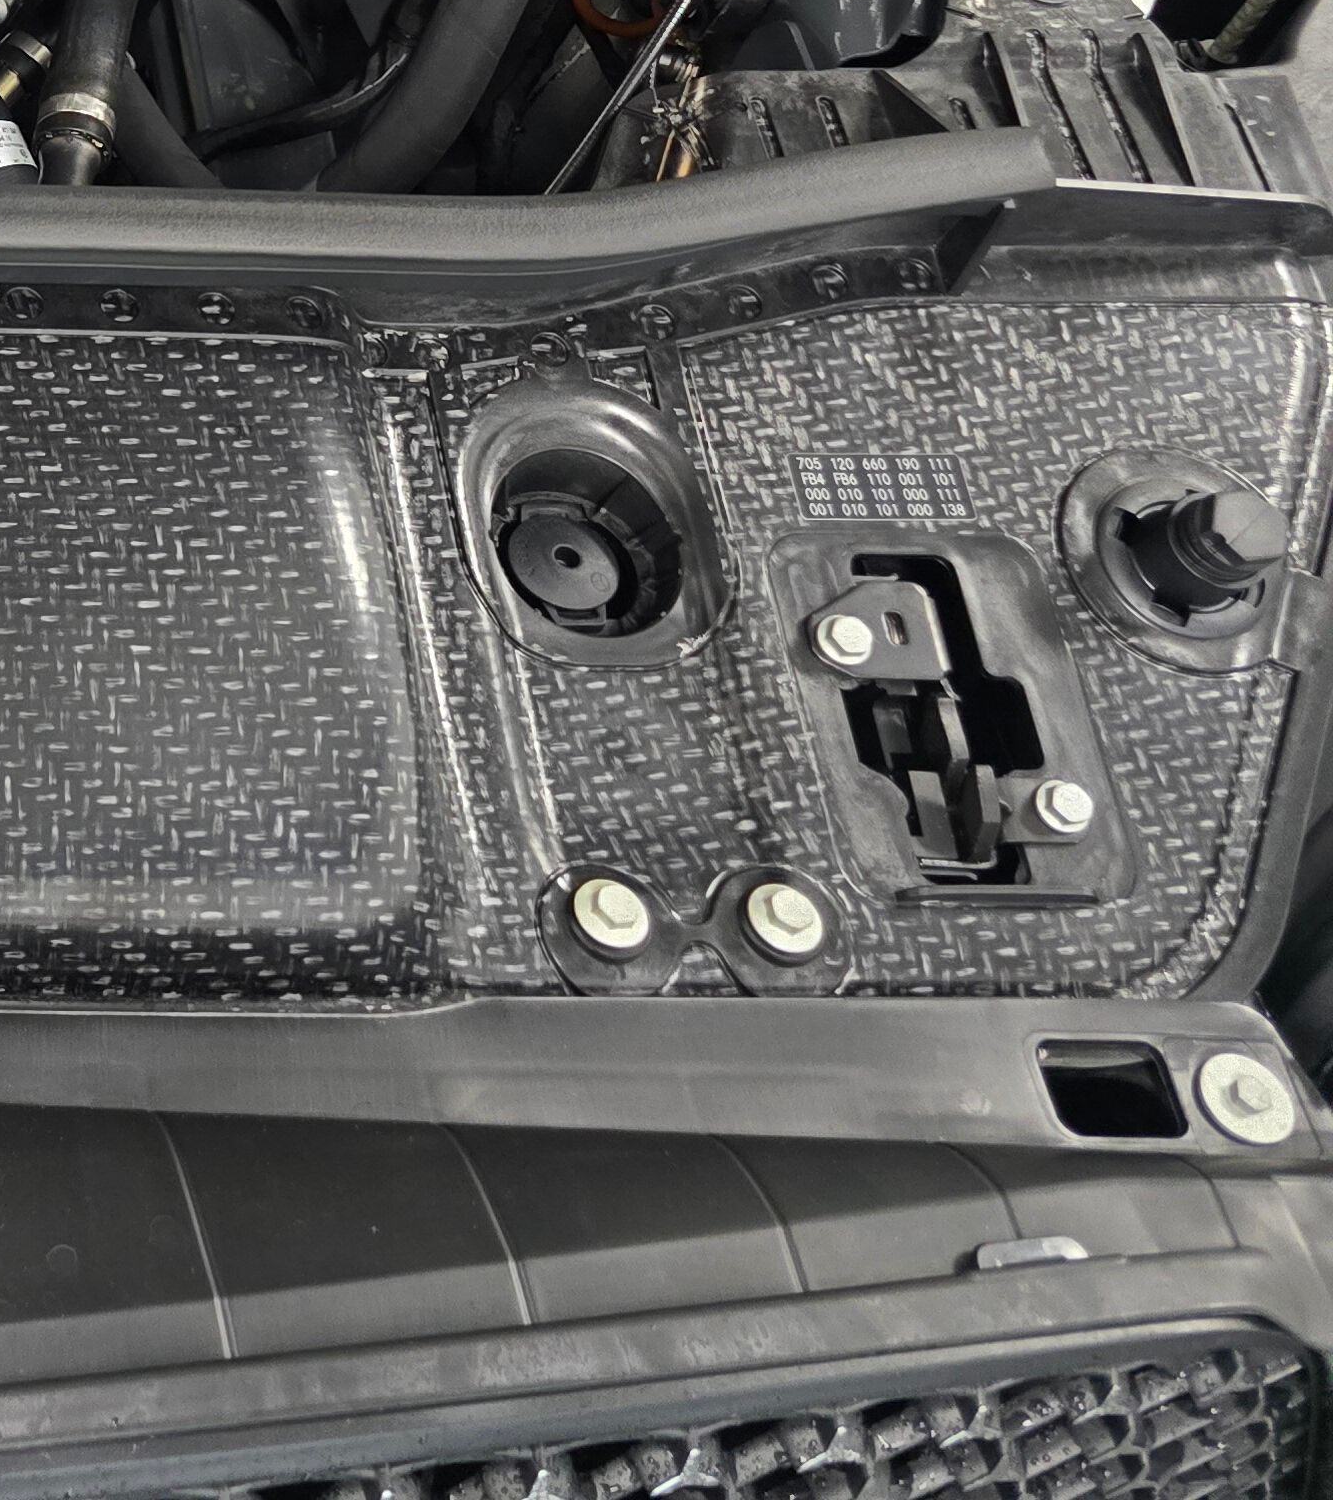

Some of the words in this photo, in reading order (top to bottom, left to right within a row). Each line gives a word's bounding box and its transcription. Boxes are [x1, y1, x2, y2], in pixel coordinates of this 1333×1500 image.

[796, 457, 822, 470] 705
[830, 457, 855, 470] 120
[862, 457, 887, 470] 660
[895, 457, 920, 470] 190
[928, 457, 951, 470] 111
[800, 472, 825, 486] FB4
[833, 472, 858, 486] FB6
[867, 472, 891, 486] 110
[898, 472, 923, 486] 001
[932, 472, 956, 486] 101
[805, 488, 830, 501] 000
[838, 488, 863, 501] 010
[871, 488, 895, 501] 101
[903, 488, 928, 501] 000
[937, 488, 961, 501] 111
[809, 503, 834, 517] 001
[842, 503, 867, 517] 010
[875, 503, 899, 517] 101
[907, 503, 933, 517] 000
[941, 503, 966, 517] 138
